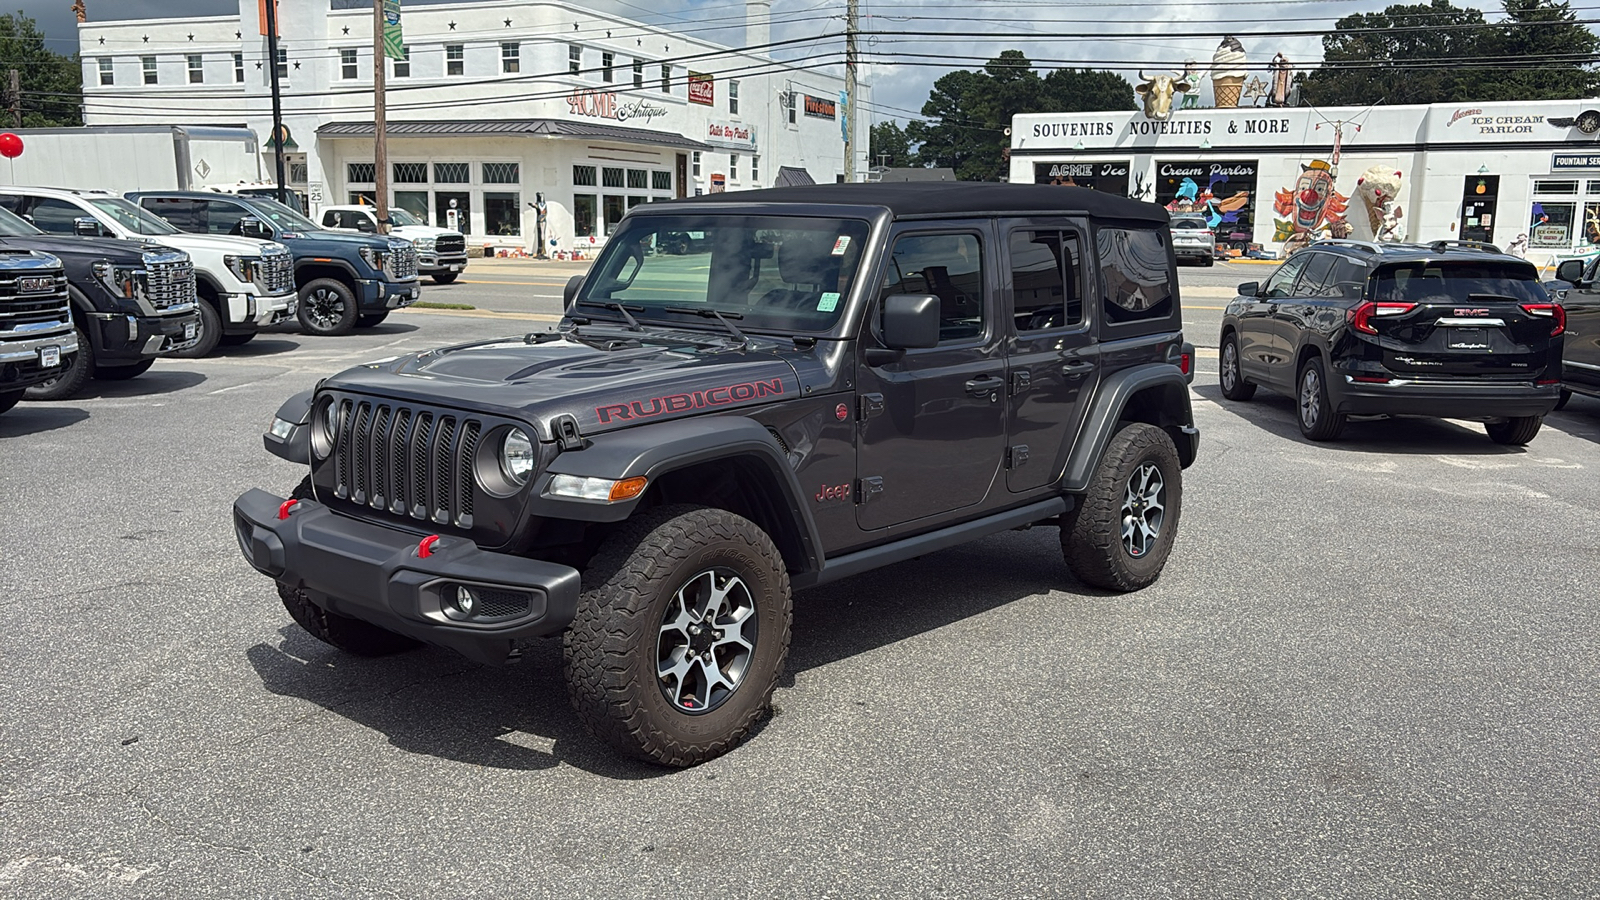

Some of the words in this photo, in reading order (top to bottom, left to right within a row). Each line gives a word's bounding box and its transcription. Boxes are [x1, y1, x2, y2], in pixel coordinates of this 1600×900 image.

[567, 86, 617, 119] ACME
[617, 97, 669, 125] Antiques
[804, 94, 835, 116] Firestone
[1471, 117, 1493, 125] ICE
[1496, 115, 1544, 124] CREAM
[709, 123, 723, 137] Dutch
[724, 125, 733, 141] Boy
[733, 127, 749, 140] Paints
[1033, 122, 1114, 137] SOUVENIRS
[1129, 120, 1212, 135] NOVELTIES
[1227, 120, 1238, 134] &
[1244, 119, 1290, 134] MORE
[1479, 125, 1533, 134] PARLOR
[1555, 157, 1588, 166] FOUNTAIN
[1049, 164, 1092, 177] ACME
[1101, 164, 1127, 176] Ice
[1160, 163, 1203, 176] Cream
[1209, 163, 1255, 176] Parlor
[311, 192, 322, 201] 25
[22, 278, 55, 291] GMC
[1453, 308, 1490, 317] GMC
[595, 378, 784, 424] RUBICON
[815, 483, 850, 502] Jeep
